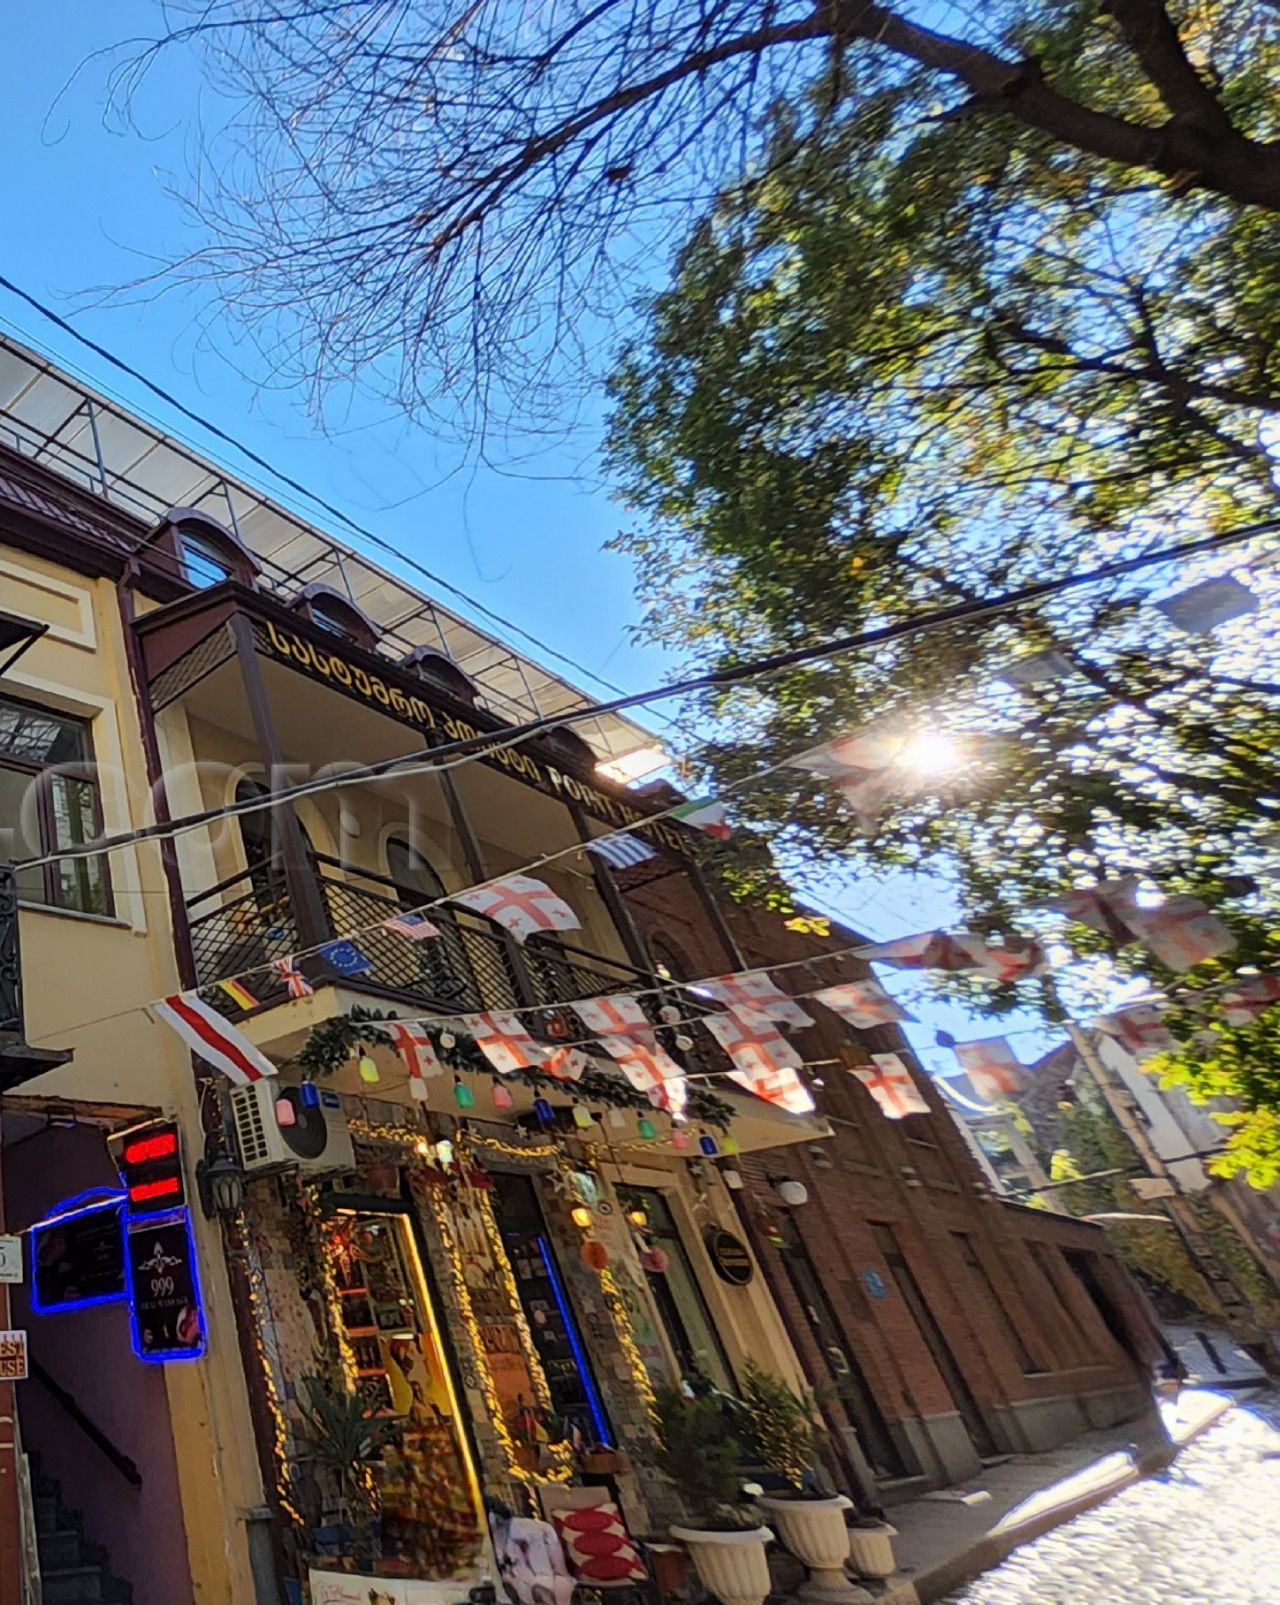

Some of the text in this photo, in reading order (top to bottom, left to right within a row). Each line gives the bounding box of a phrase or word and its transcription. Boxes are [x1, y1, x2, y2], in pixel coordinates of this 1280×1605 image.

[266, 620, 436, 729] სასტუმრო
[545, 765, 618, 819] POINT
[151, 1276, 174, 1297] 999
